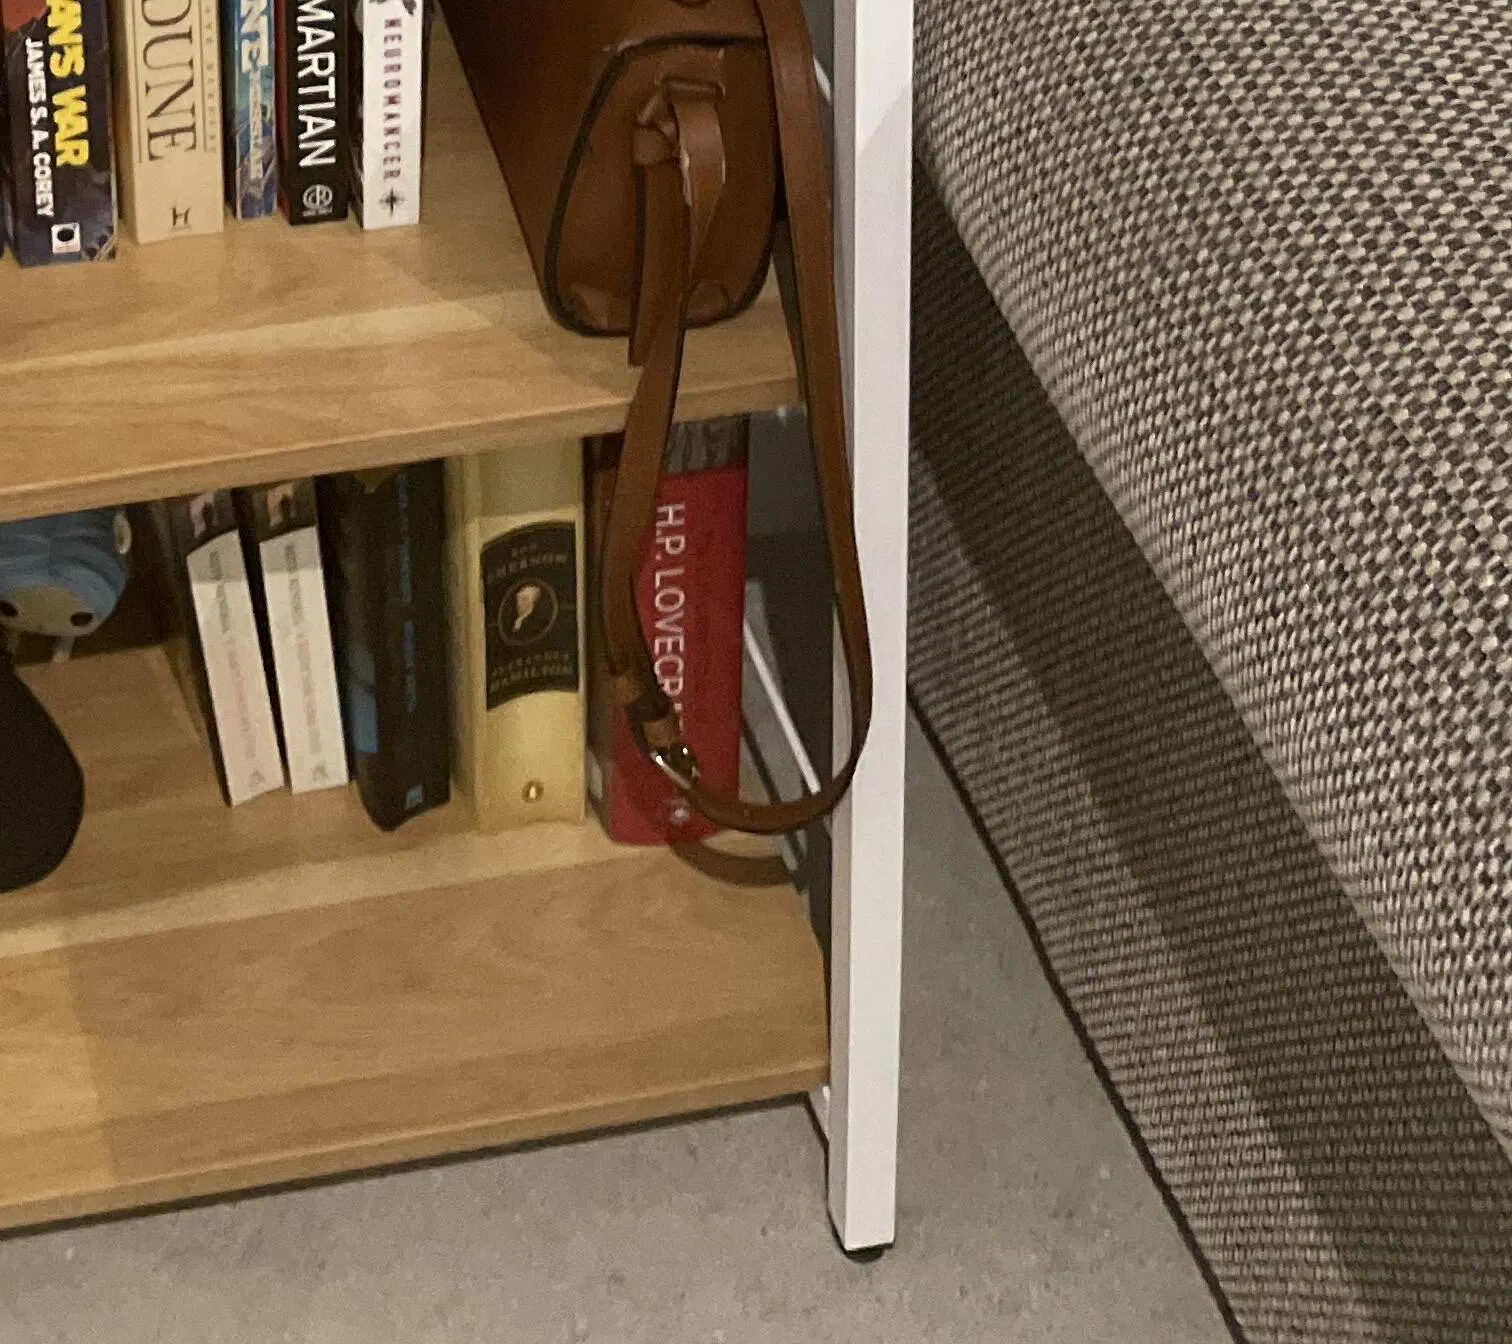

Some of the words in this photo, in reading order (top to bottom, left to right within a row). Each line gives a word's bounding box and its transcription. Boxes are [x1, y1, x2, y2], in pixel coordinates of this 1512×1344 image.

[24, 36, 47, 104] JAMES
[382, 18, 401, 182] NEUROMANCER
[29, 106, 48, 125] S.
[31, 127, 49, 150] A.
[53, 84, 89, 167] WAR
[31, 151, 54, 217] COREY
[653, 501, 688, 562] H.P.
[651, 566, 687, 733] LOVECR
